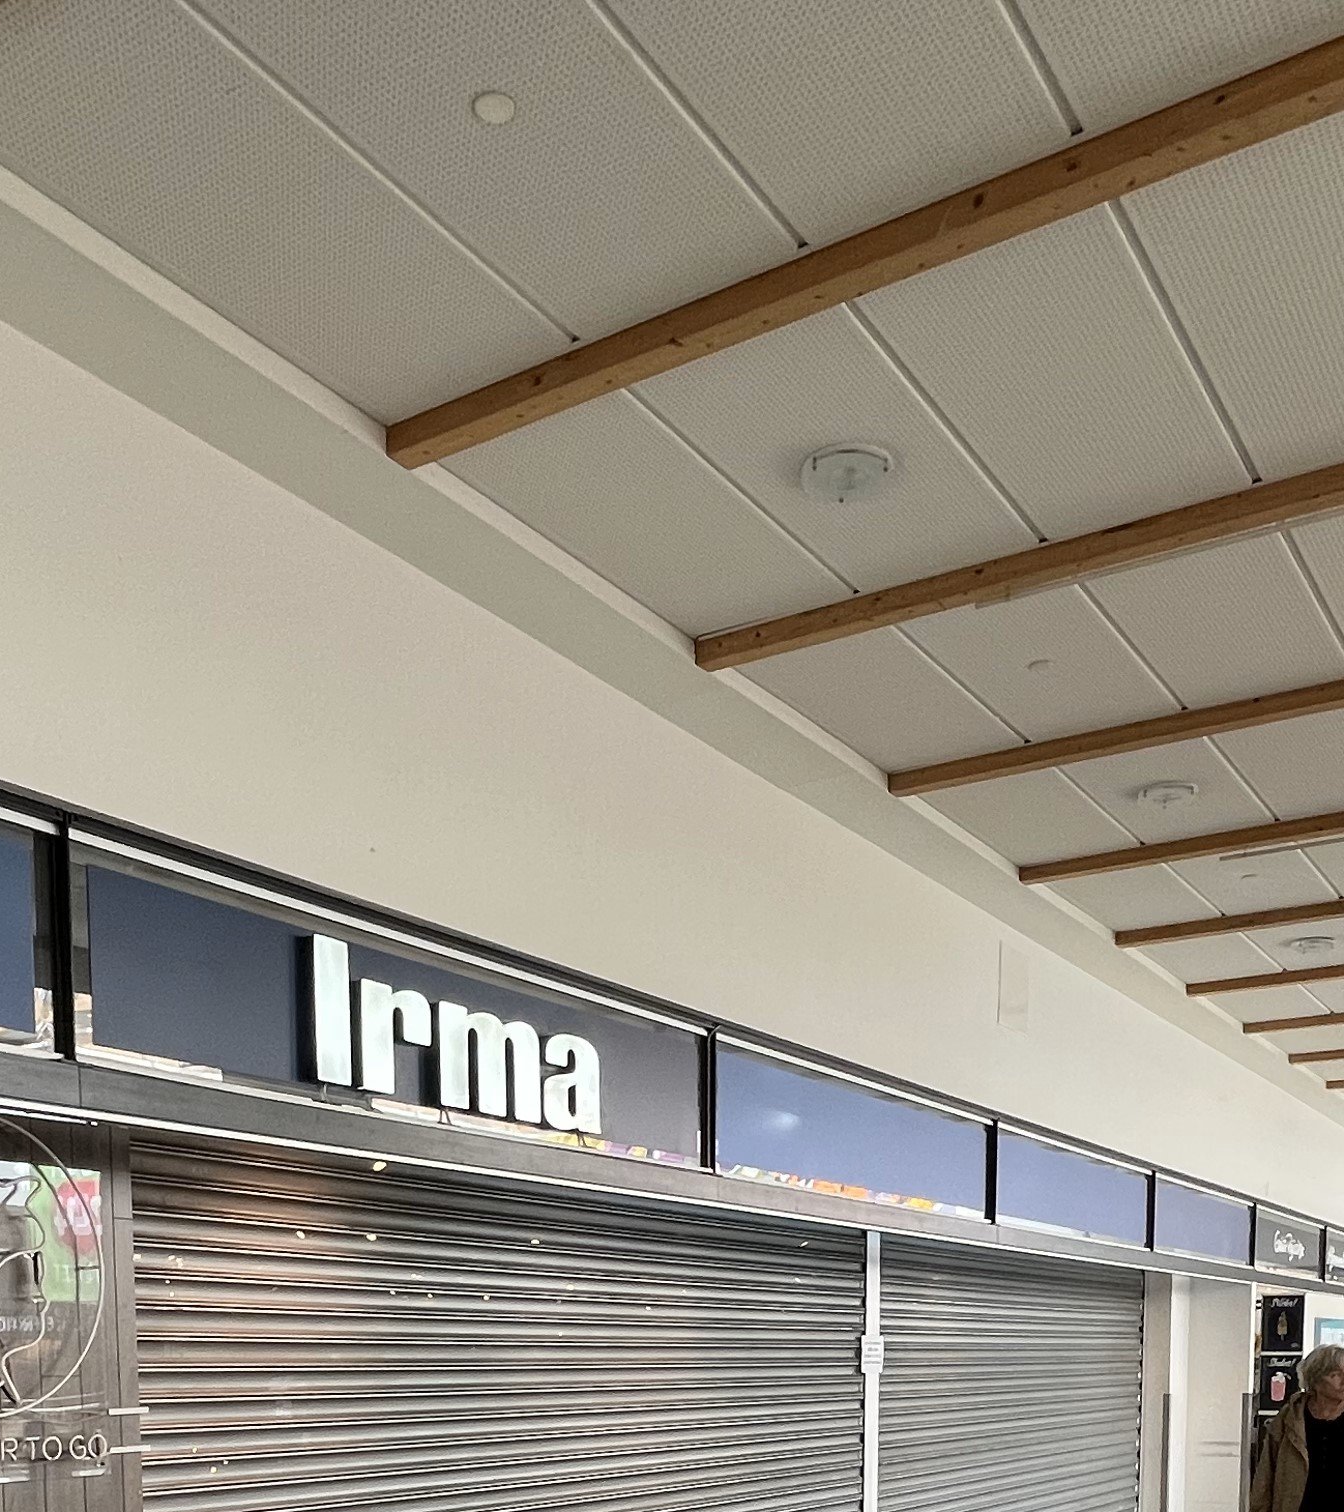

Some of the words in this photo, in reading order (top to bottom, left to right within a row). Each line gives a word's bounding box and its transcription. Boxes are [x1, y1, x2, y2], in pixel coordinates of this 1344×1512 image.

[311, 932, 603, 1135] Irma
[25, 1435, 63, 1461] TO
[68, 1433, 108, 1461] GO
